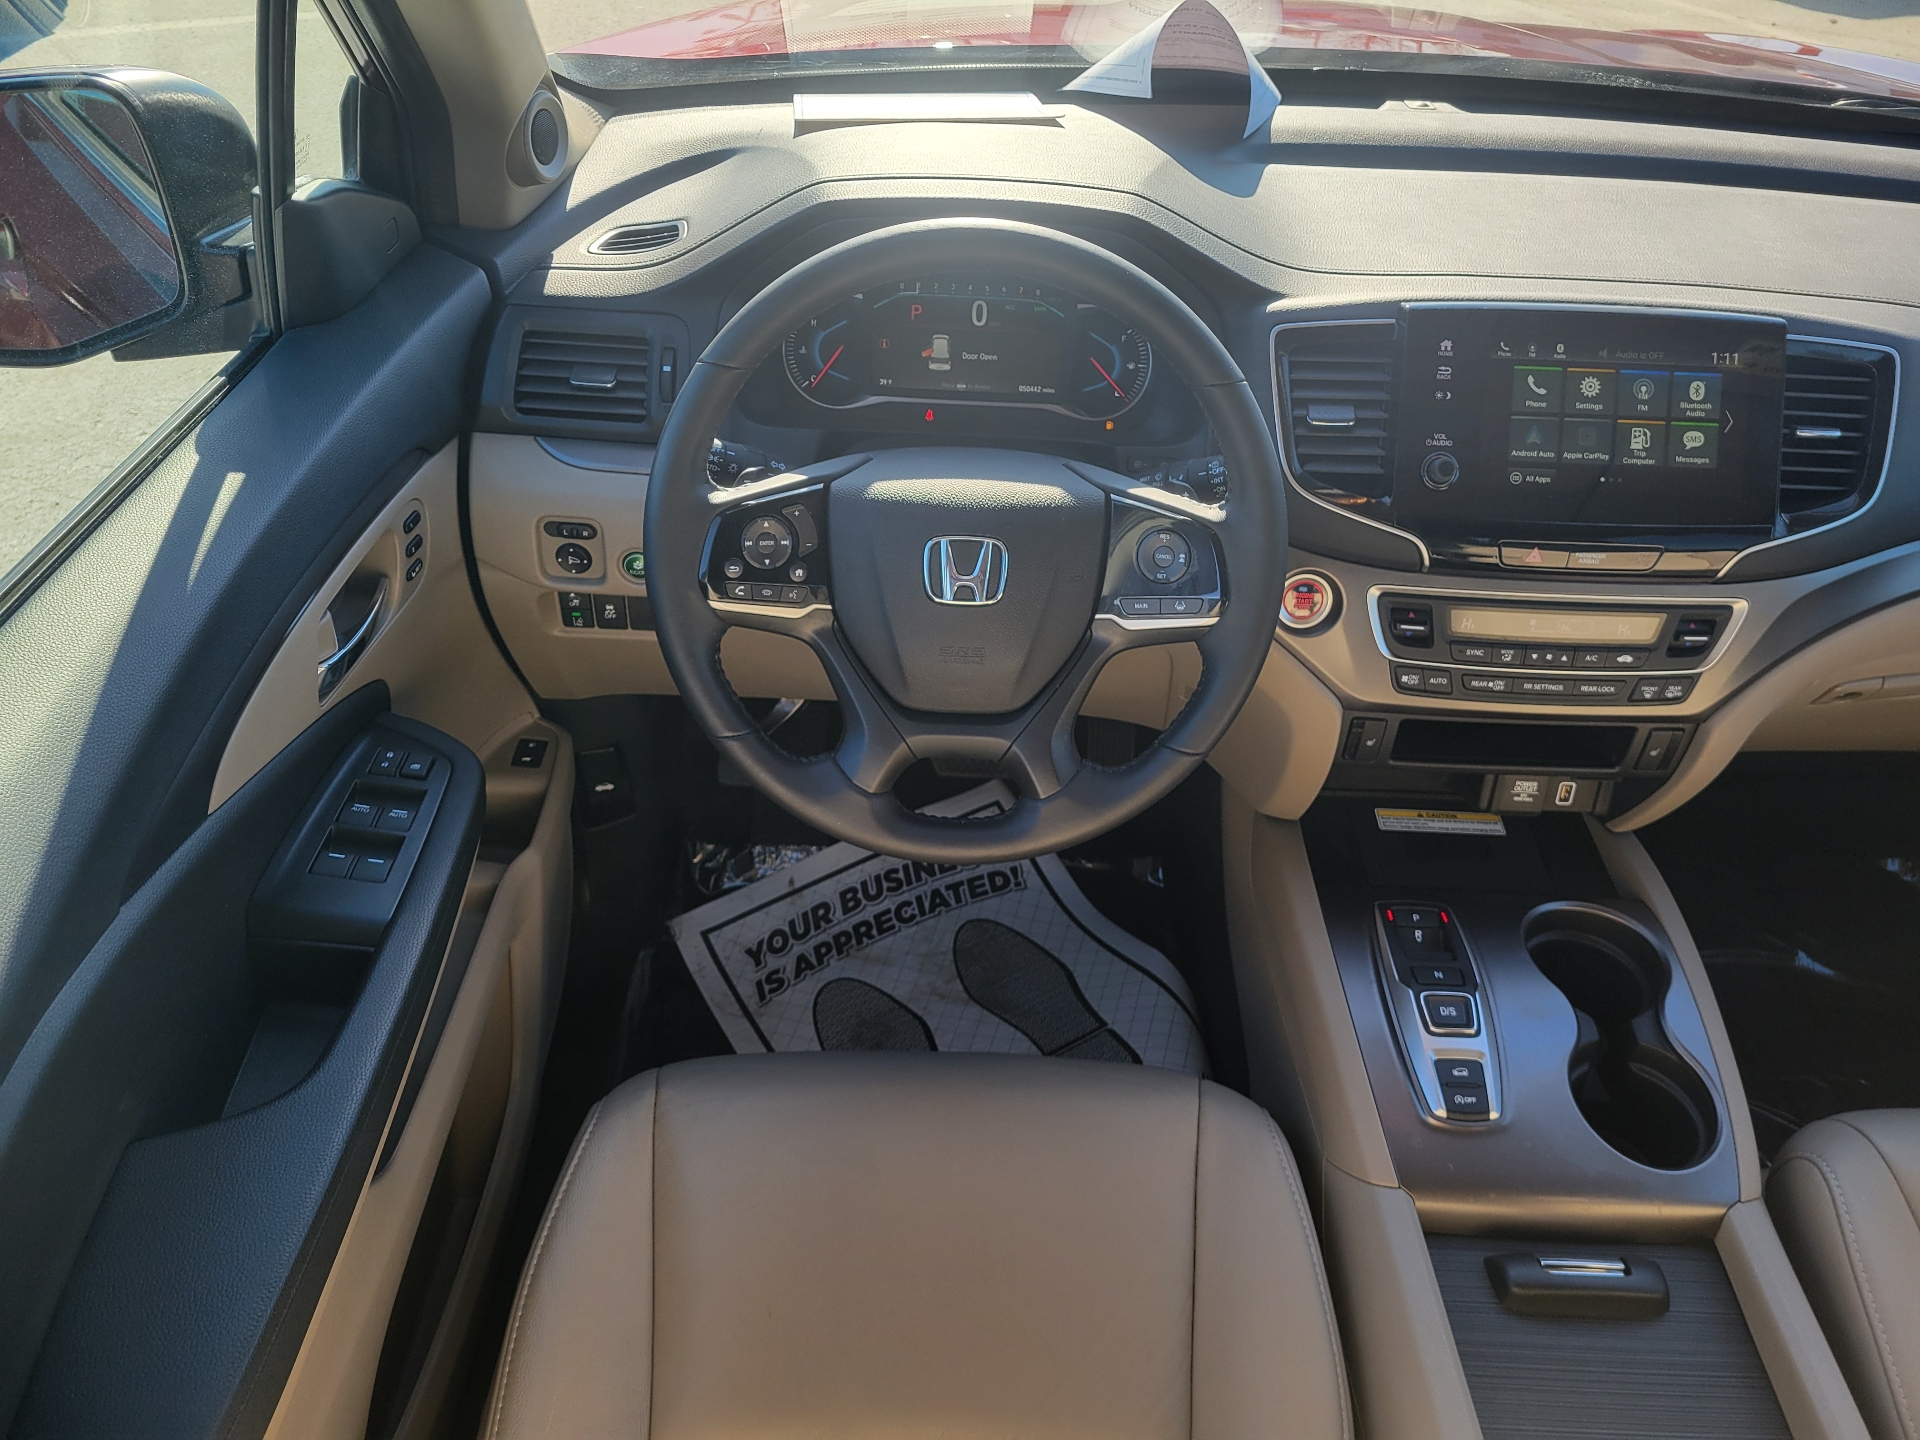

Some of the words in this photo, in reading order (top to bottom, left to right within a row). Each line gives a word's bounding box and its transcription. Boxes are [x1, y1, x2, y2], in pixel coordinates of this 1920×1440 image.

[911, 304, 923, 321] P
[971, 300, 988, 327] 0
[811, 319, 817, 327] H
[962, 352, 978, 360] Door
[980, 353, 998, 361] Open
[1615, 350, 1638, 359] Audio
[1648, 351, 1665, 359] OFF
[1711, 352, 1739, 365] 1:11
[1018, 385, 1041, 393] 050442
[1525, 400, 1547, 408] Phone
[1575, 402, 1603, 411] Settings
[1679, 402, 1712, 410] Bluetooth
[1685, 435, 1702, 444] SMS
[1538, 450, 1555, 458] Auto
[1562, 452, 1583, 460] Apple
[1583, 452, 1609, 461] CarPlay
[1633, 450, 1647, 458] Trip
[1622, 457, 1656, 465] Computer
[1675, 456, 1710, 464] Messages
[1465, 648, 1485, 657] SYNC
[1429, 677, 1448, 685] AUTO
[1533, 683, 1564, 691] SETTINGS
[388, 811, 408, 819] AUTO
[744, 901, 834, 968] YOUR
[839, 860, 957, 917] BUSIN
[1412, 914, 1420, 922] P
[755, 967, 786, 1003] IS
[793, 865, 1022, 981] APPRECIATED!
[1414, 929, 1423, 938] R
[1433, 970, 1444, 980] N
[1439, 1006, 1457, 1017] D/S
[1464, 1096, 1477, 1104] OFF
